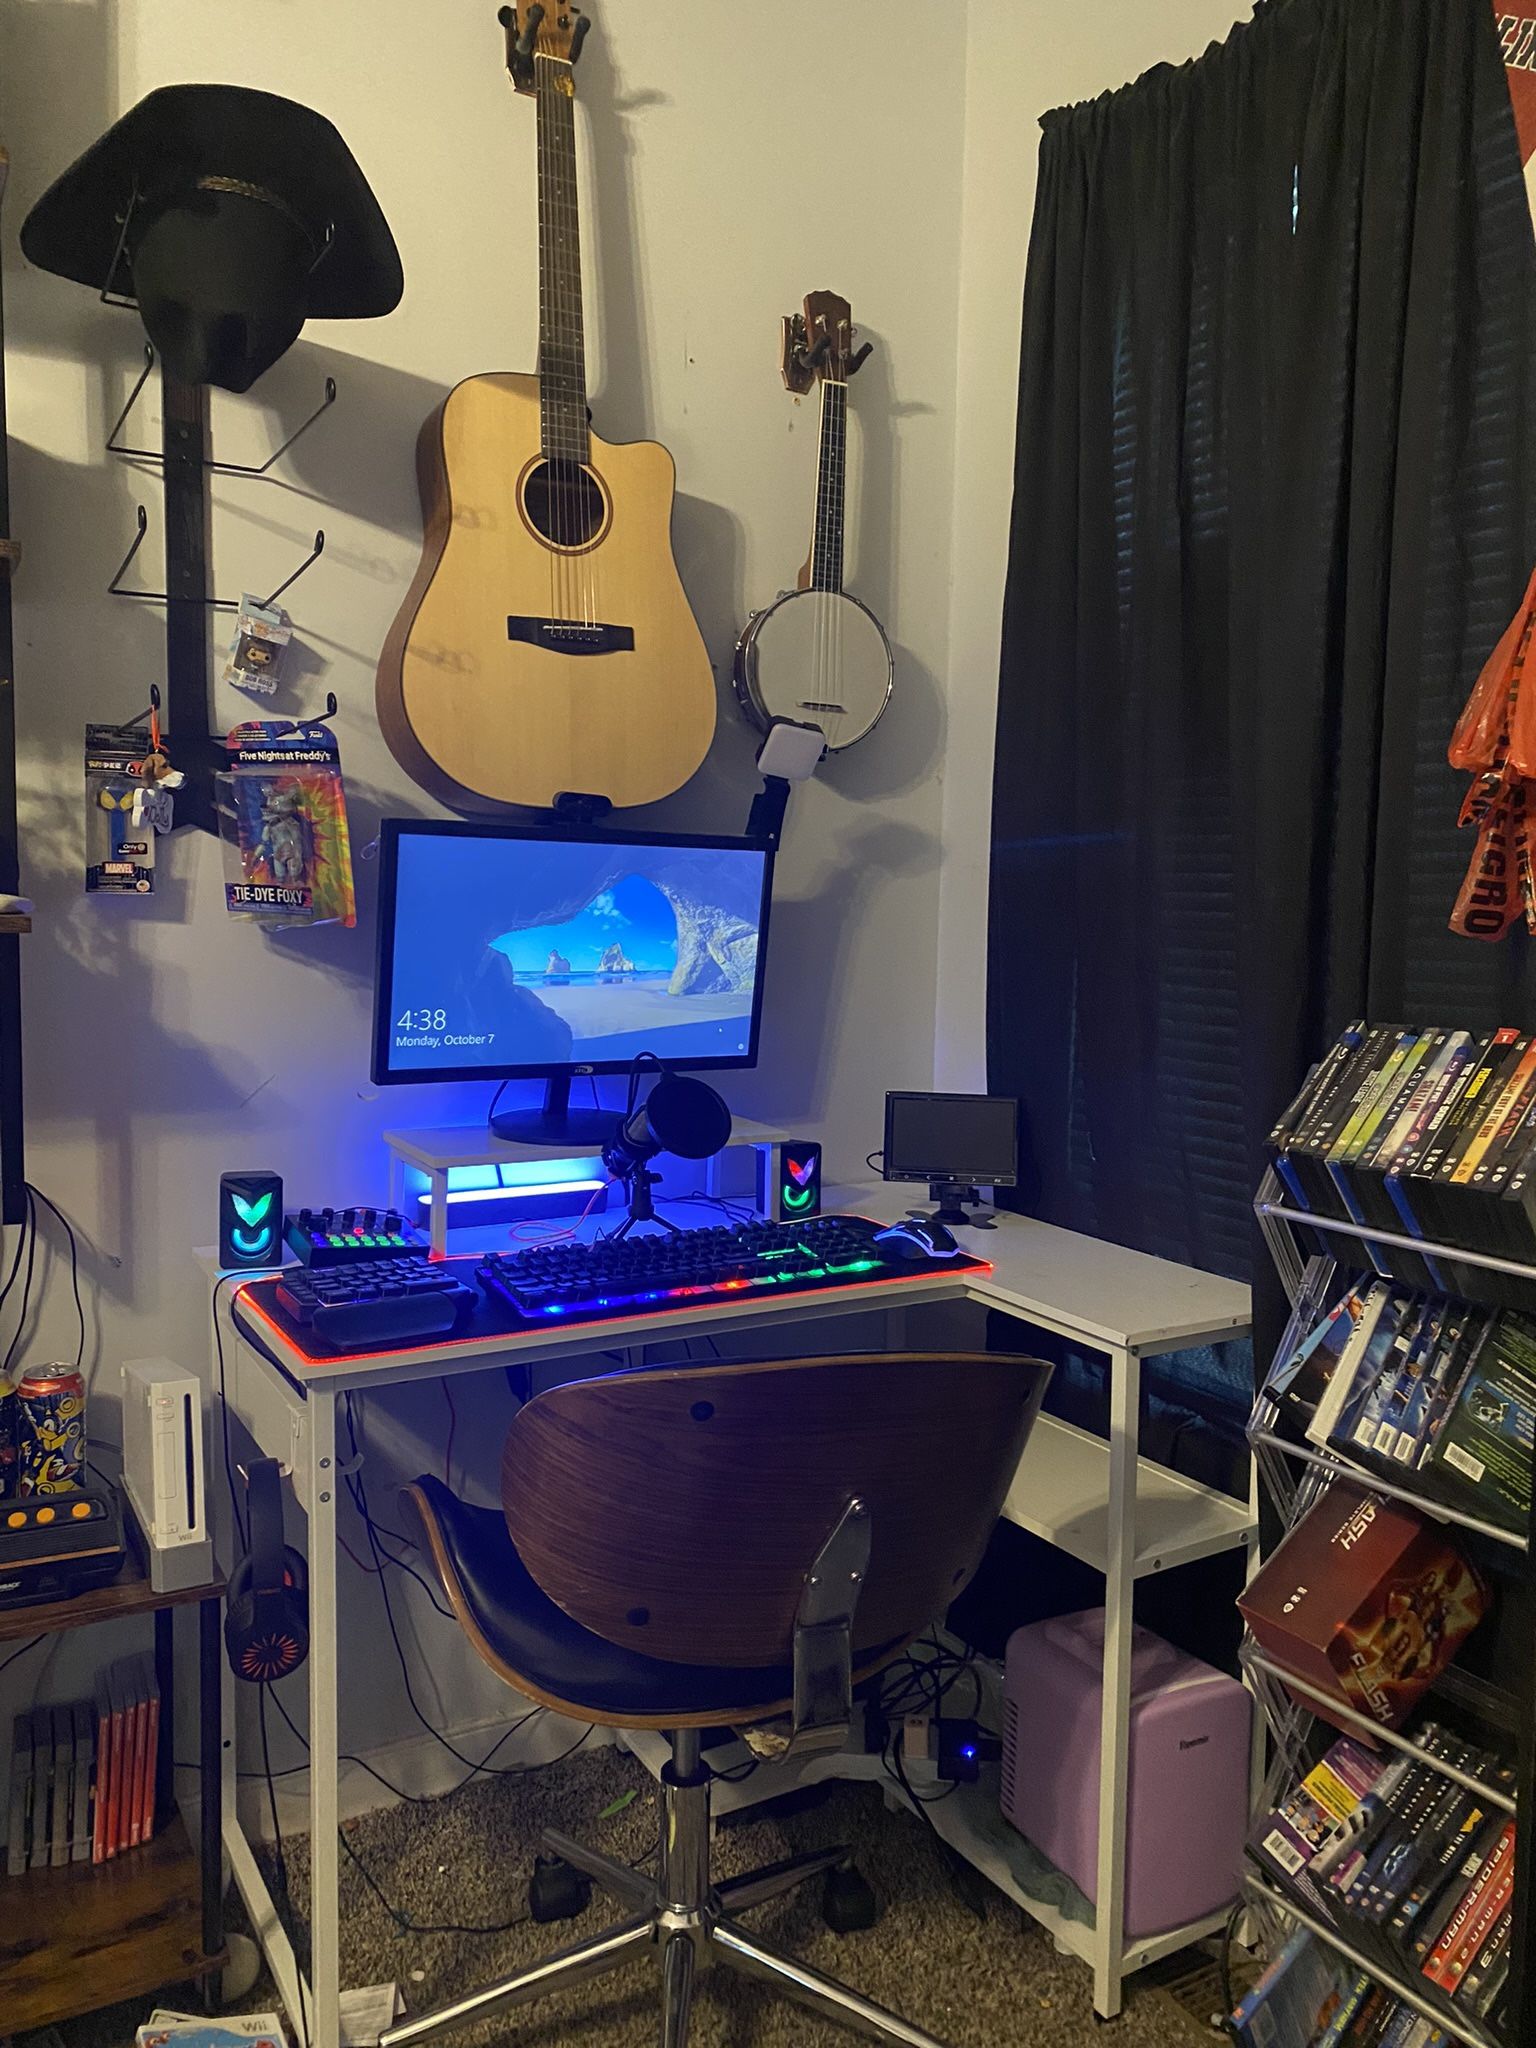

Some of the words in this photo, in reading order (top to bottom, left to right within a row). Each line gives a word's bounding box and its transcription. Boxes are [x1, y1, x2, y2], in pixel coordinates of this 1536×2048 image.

[239, 750, 257, 761] Five
[258, 751, 286, 762] Nights
[286, 752, 295, 761] at
[295, 751, 332, 764] Freddy's
[104, 862, 134, 875] MARVEL
[234, 886, 275, 902] TIE-DYE
[276, 888, 303, 904] FOXY
[397, 1008, 446, 1031] 4:38
[396, 1036, 441, 1048] Monday,
[444, 1034, 486, 1046] October
[488, 1033, 495, 1044] 7
[1386, 1064, 1426, 1120] AQUAMAN
[1495, 1094, 1530, 1136] FLASH
[178, 1532, 193, 1543] Wii
[1350, 1651, 1395, 1721] FLASH
[1385, 1768, 1416, 1807] LANTERN
[1410, 1800, 1435, 1834] KNIGHT
[1440, 1836, 1510, 1949] SPIDER-MAN
[1477, 1951, 1494, 1969] 3
[241, 2020, 268, 2033] Wii
